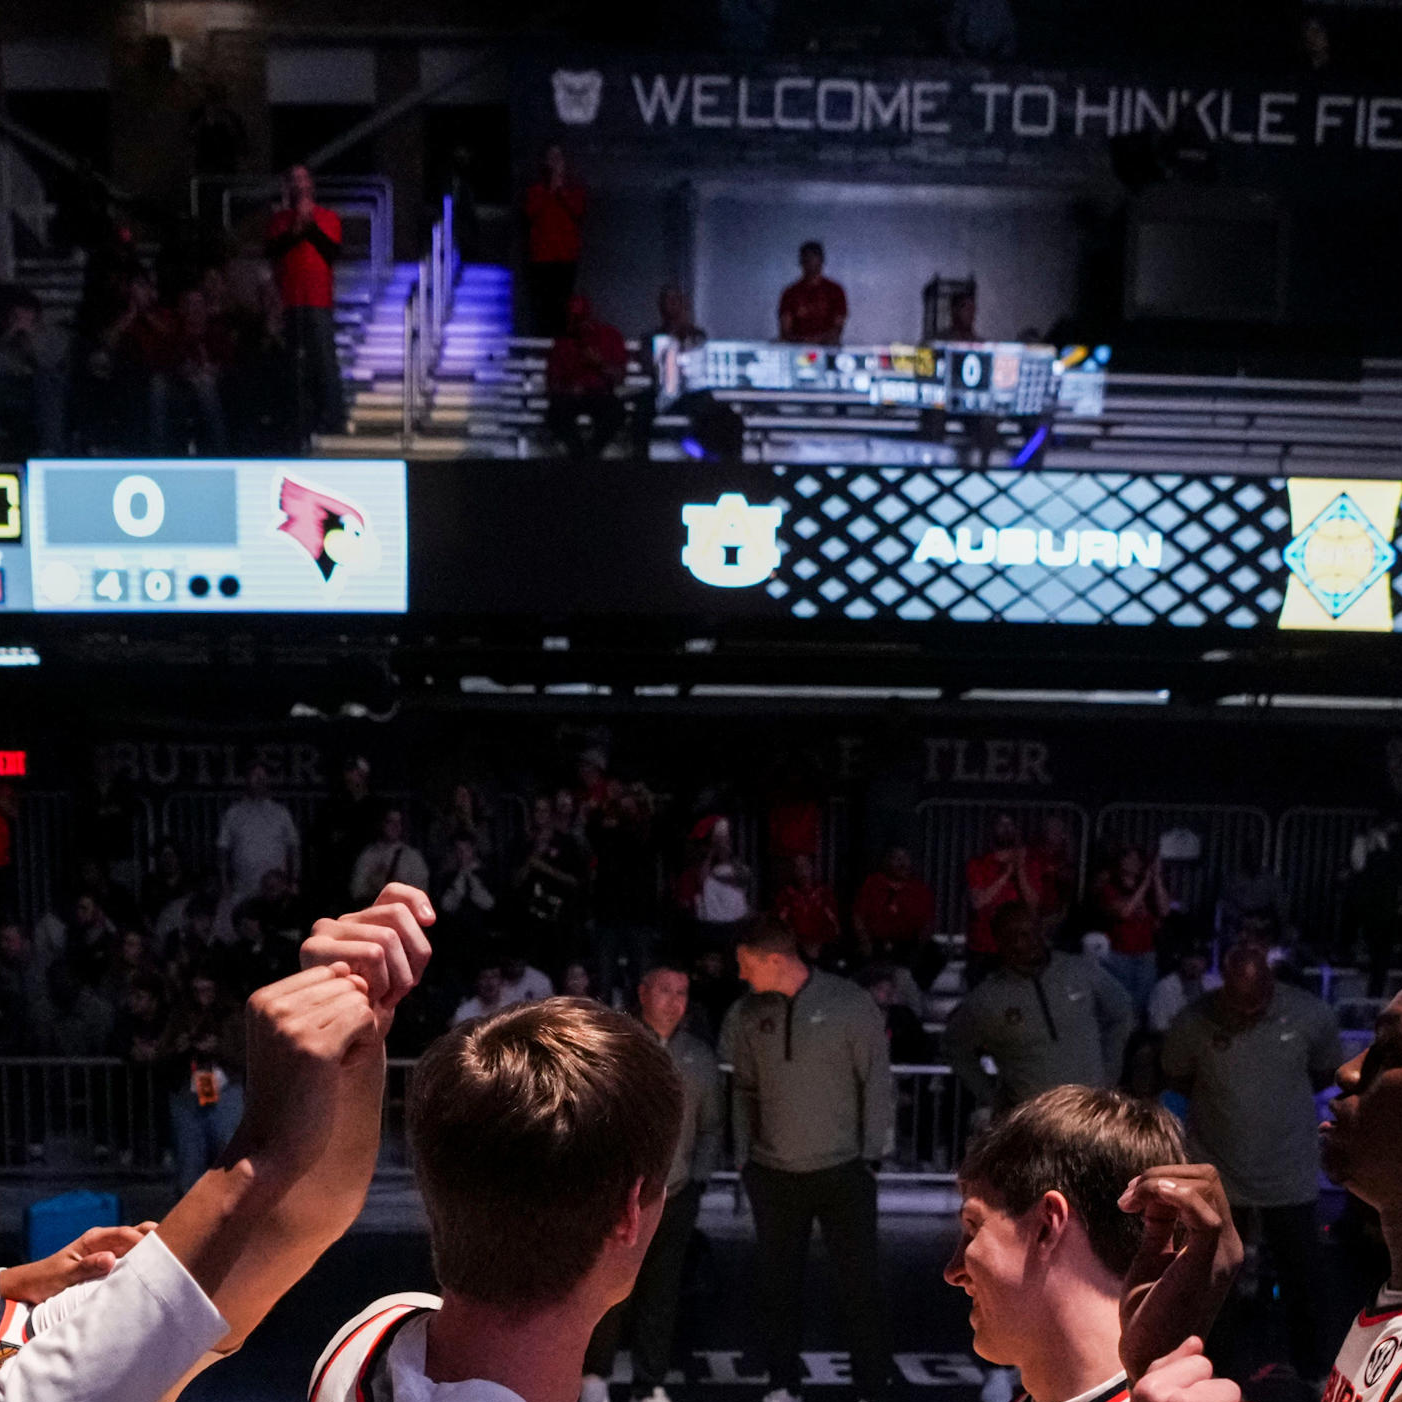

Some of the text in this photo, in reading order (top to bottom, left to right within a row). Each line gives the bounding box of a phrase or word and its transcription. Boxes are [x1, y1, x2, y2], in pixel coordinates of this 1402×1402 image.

[632, 73, 951, 134] WELCOME
[972, 83, 1057, 137] TO
[112, 475, 166, 537] 0
[912, 525, 1163, 569] AUBURN
[96, 570, 172, 601] 4 0
[922, 737, 1054, 785] TLER
